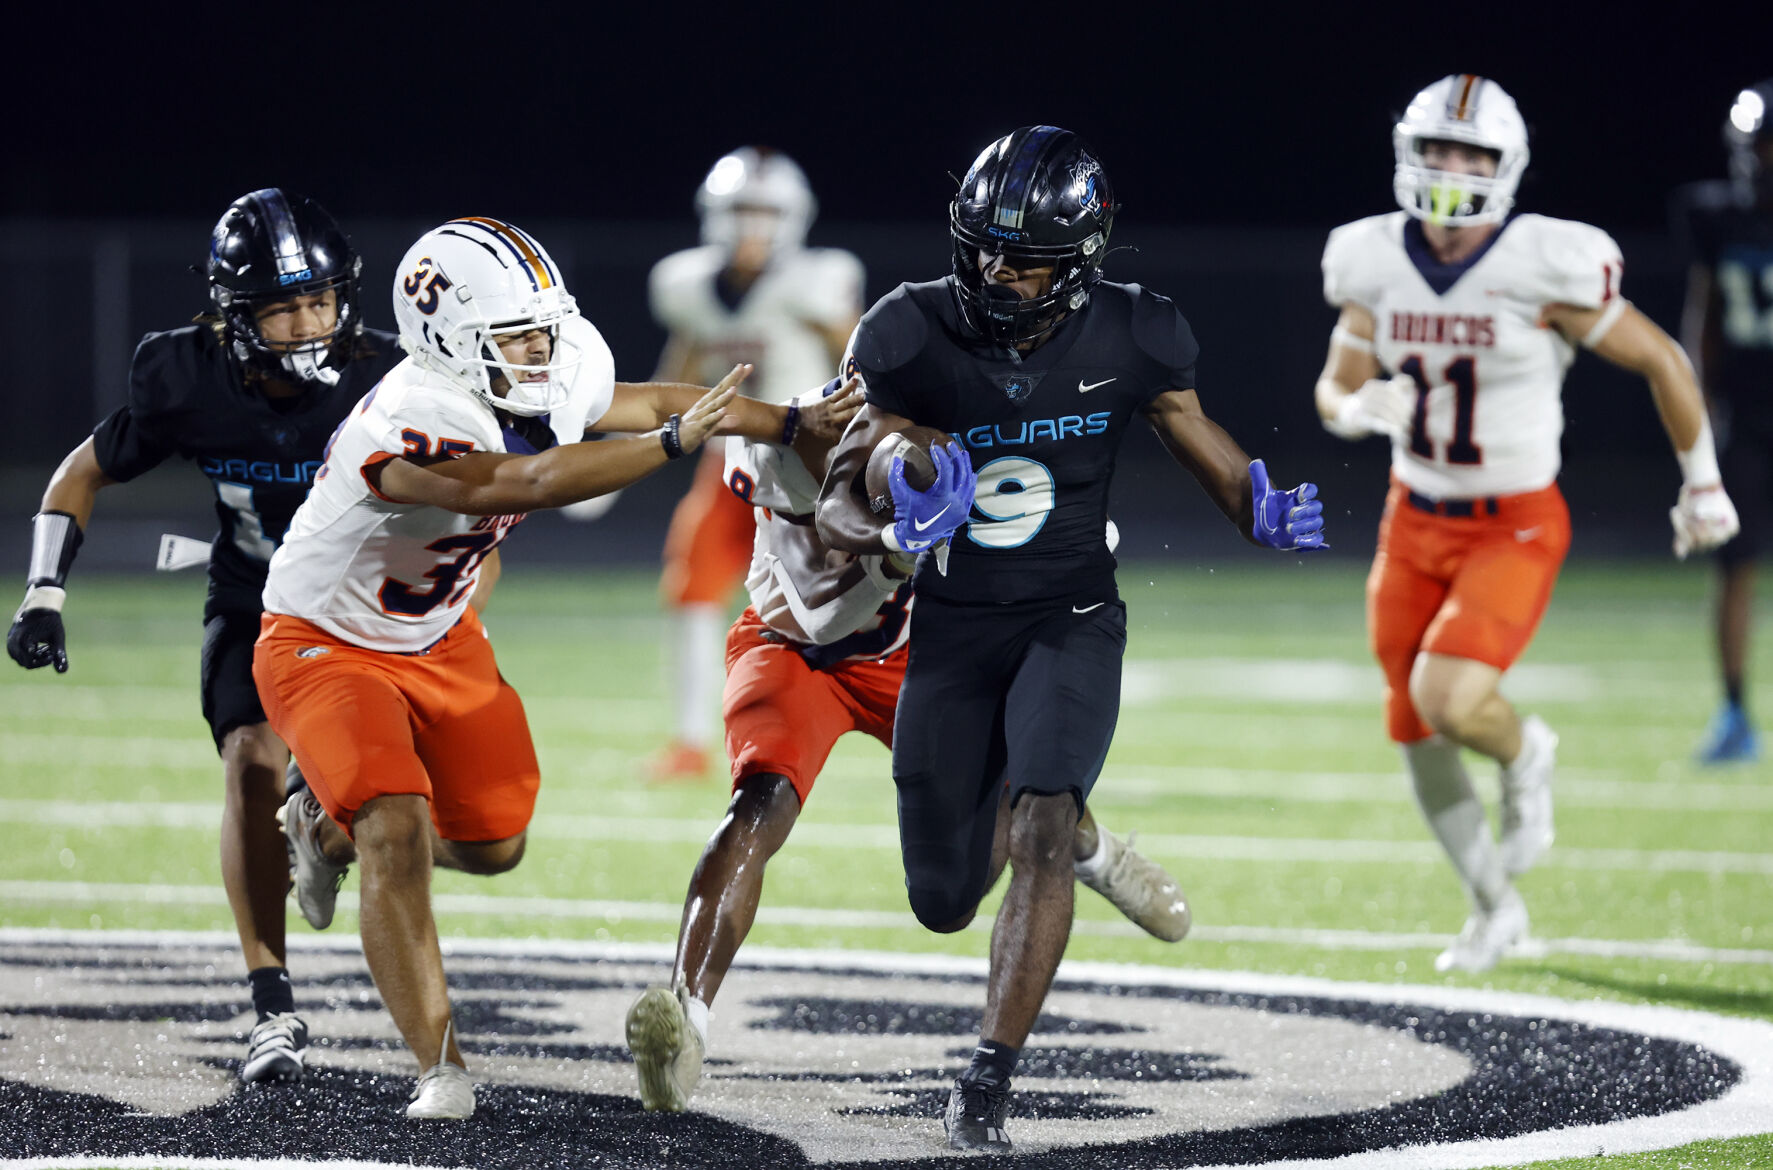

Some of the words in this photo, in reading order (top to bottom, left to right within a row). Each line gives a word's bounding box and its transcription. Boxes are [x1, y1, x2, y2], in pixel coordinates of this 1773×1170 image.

[404, 256, 451, 315] 35
[1391, 311, 1495, 347] BRONCOS
[1400, 352, 1483, 464] 11
[967, 455, 1055, 549] 9
